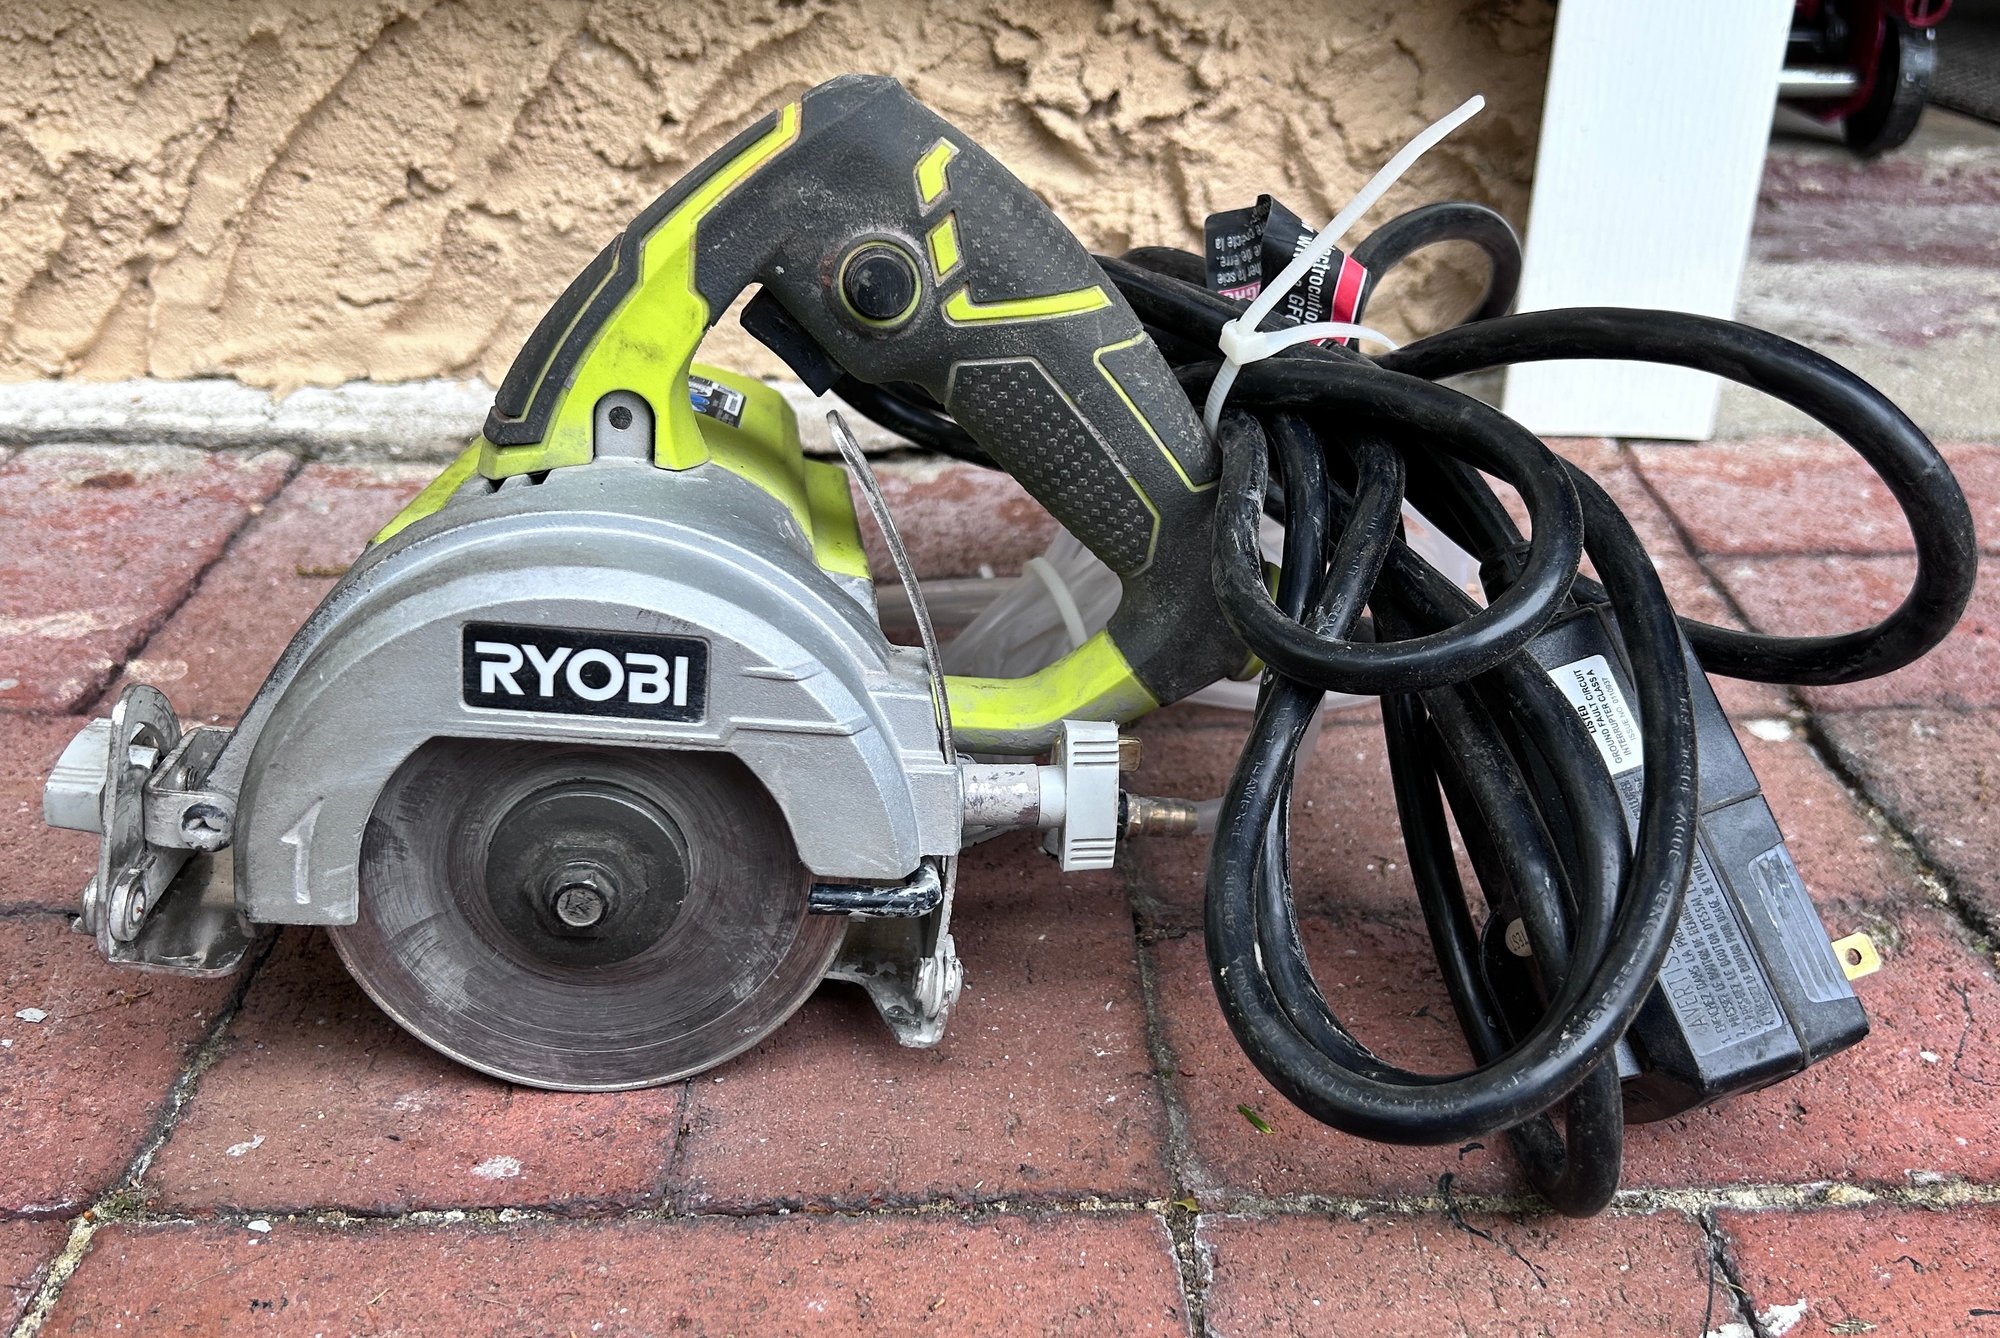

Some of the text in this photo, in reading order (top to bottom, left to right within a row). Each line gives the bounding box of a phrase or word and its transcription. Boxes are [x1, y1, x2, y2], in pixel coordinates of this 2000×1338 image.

[474, 641, 689, 706] RYOBI
[1589, 676, 1606, 703] CLASS
[1573, 669, 1623, 764] GROUND FAULT CIRCUIT
[1578, 705, 1597, 734] LISTED
[1601, 702, 1632, 756] INTERRUPTER
[1621, 719, 1636, 741] ISSUE
[1682, 949, 1695, 963] LA
